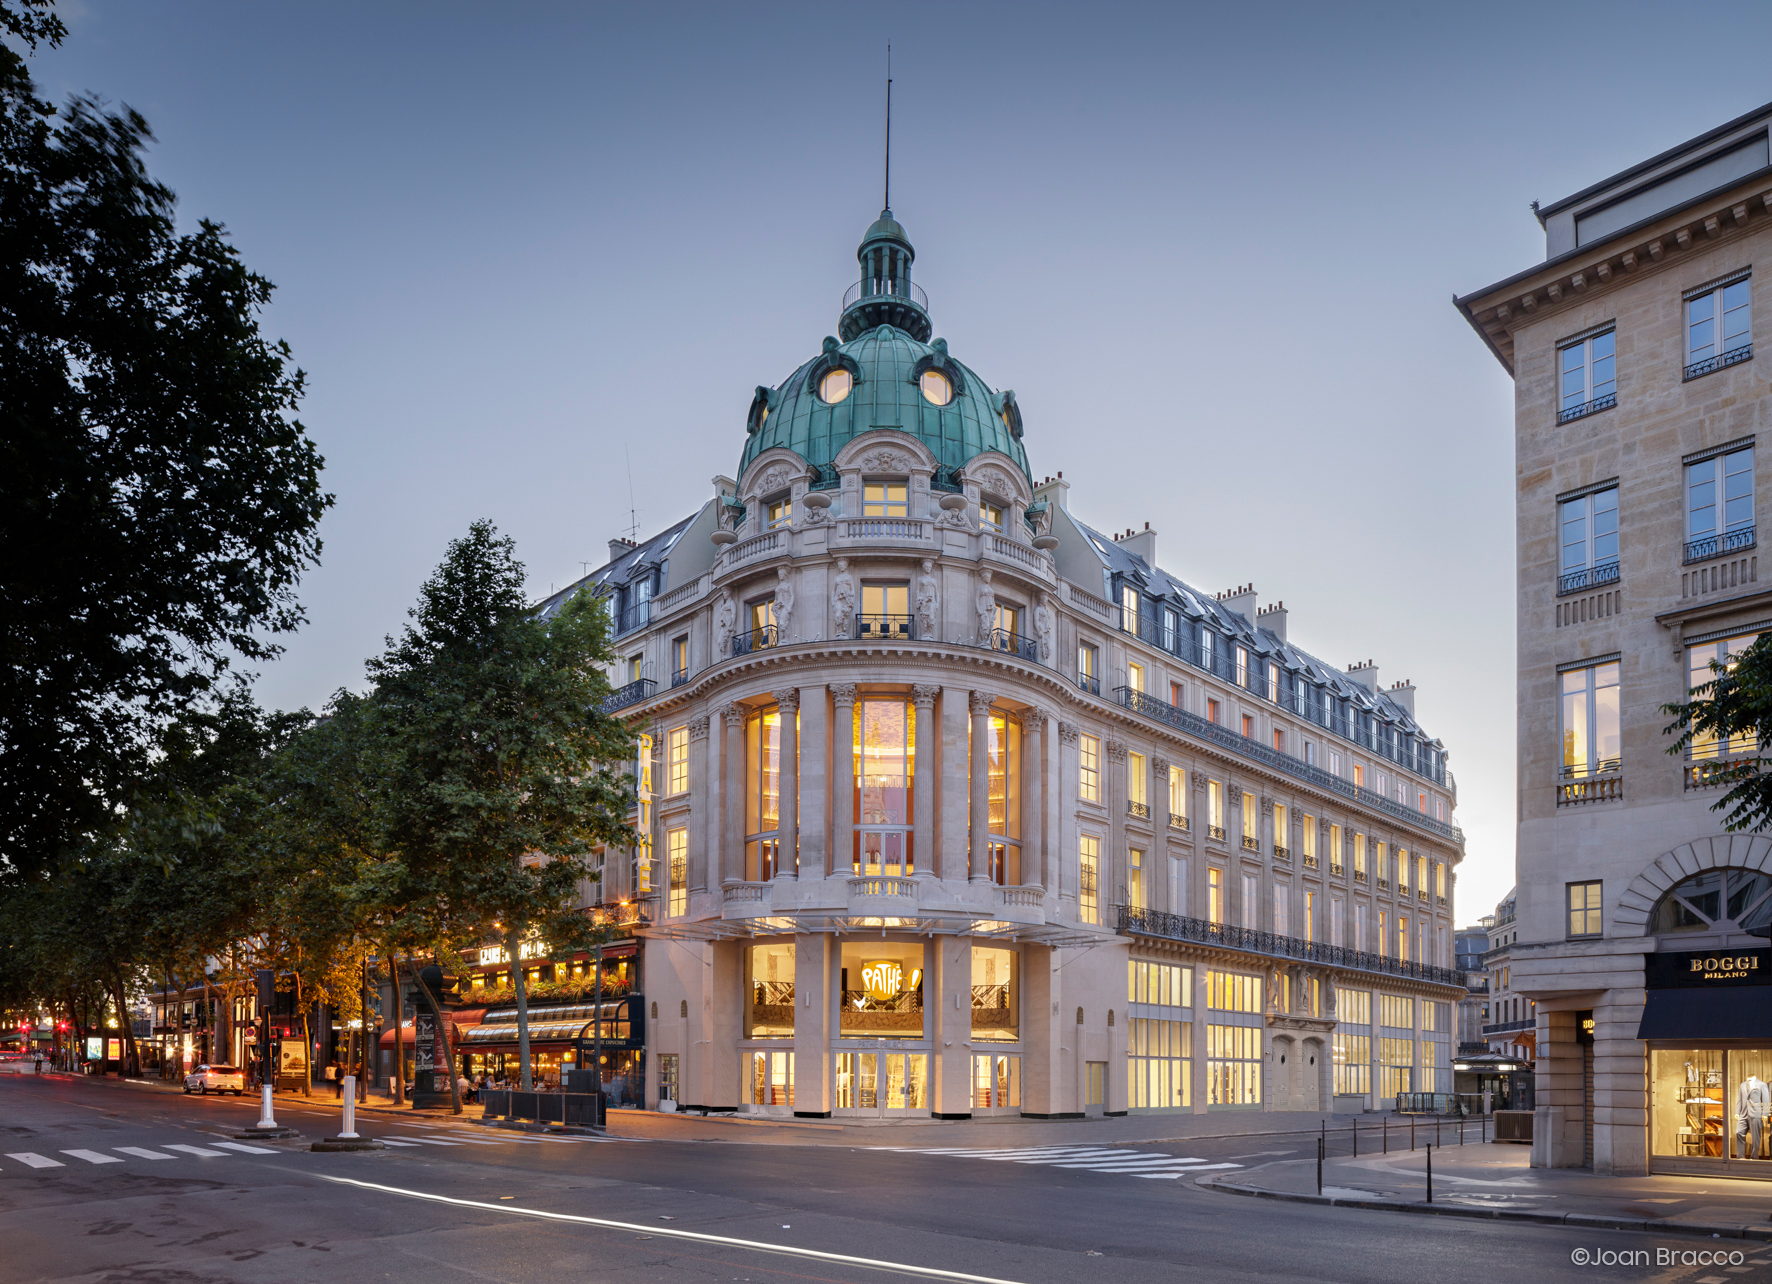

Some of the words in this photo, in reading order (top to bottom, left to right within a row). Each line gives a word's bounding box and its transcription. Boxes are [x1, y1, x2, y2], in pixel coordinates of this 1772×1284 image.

[638, 733, 653, 892] PATHÉ
[1690, 956, 1759, 971] BOGGI
[1704, 971, 1748, 979] MILANO
[862, 964, 903, 996] PATHÉ
